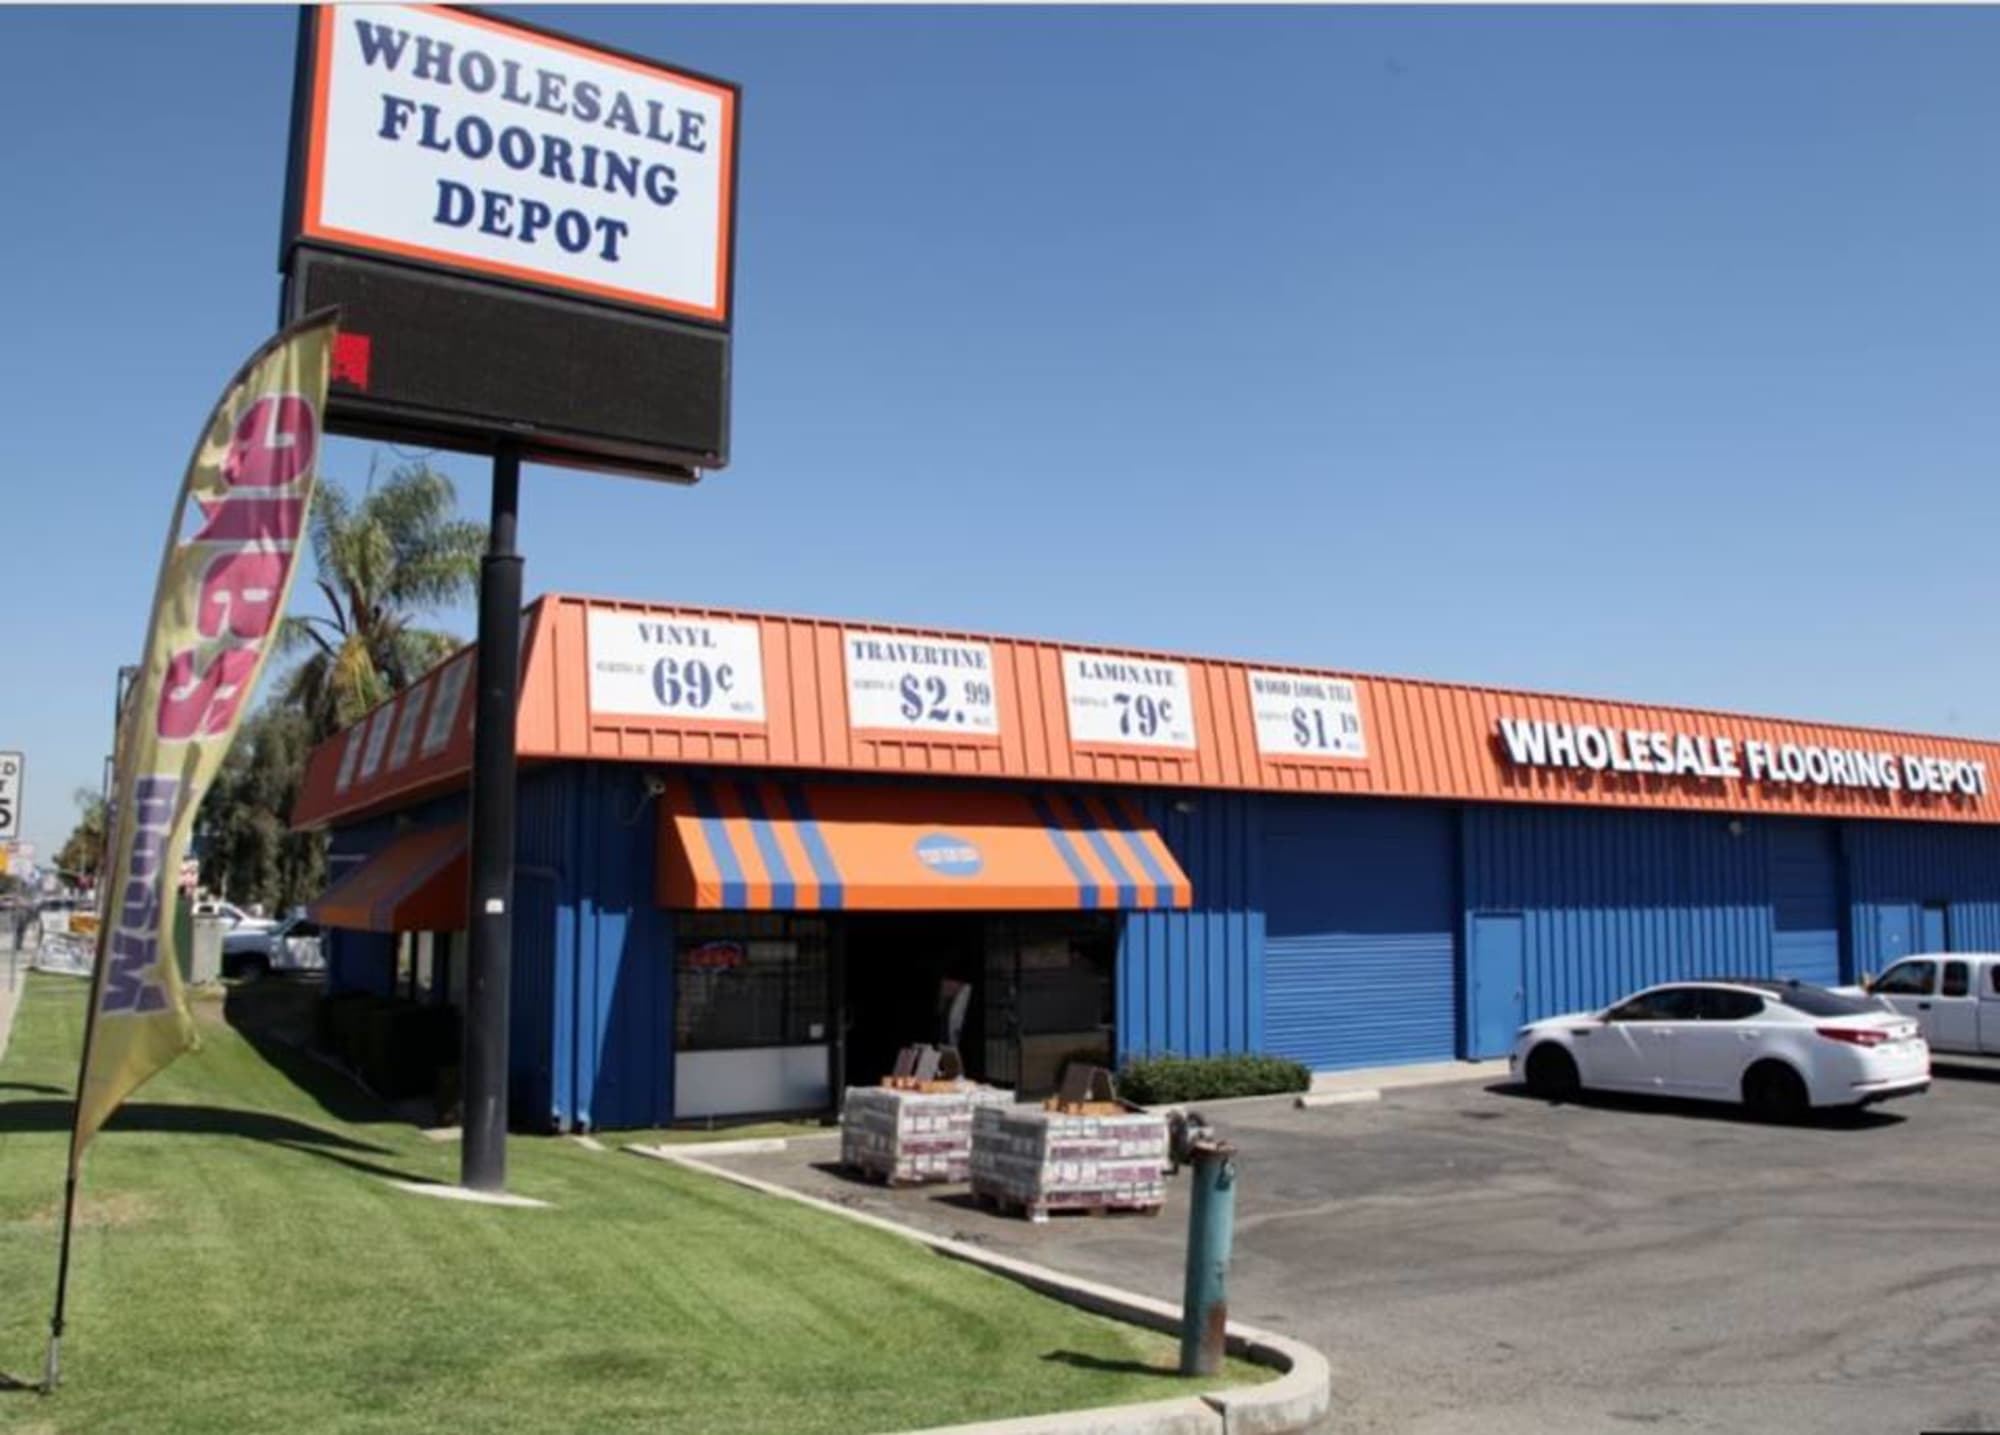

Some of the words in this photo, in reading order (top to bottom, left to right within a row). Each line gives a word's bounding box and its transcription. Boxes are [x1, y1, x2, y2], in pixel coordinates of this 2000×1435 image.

[355, 19, 706, 153] WHOLESALE
[379, 94, 678, 205] FLOORING
[433, 179, 628, 262] DEPOT
[638, 622, 716, 649] VINYL
[852, 640, 986, 669] TRAVERTINE
[1079, 660, 1176, 687] LAMINATE
[1501, 718, 1740, 777] WHOLESALE
[1746, 740, 1899, 790] FLOORING
[1902, 755, 1987, 796] DEPOT
